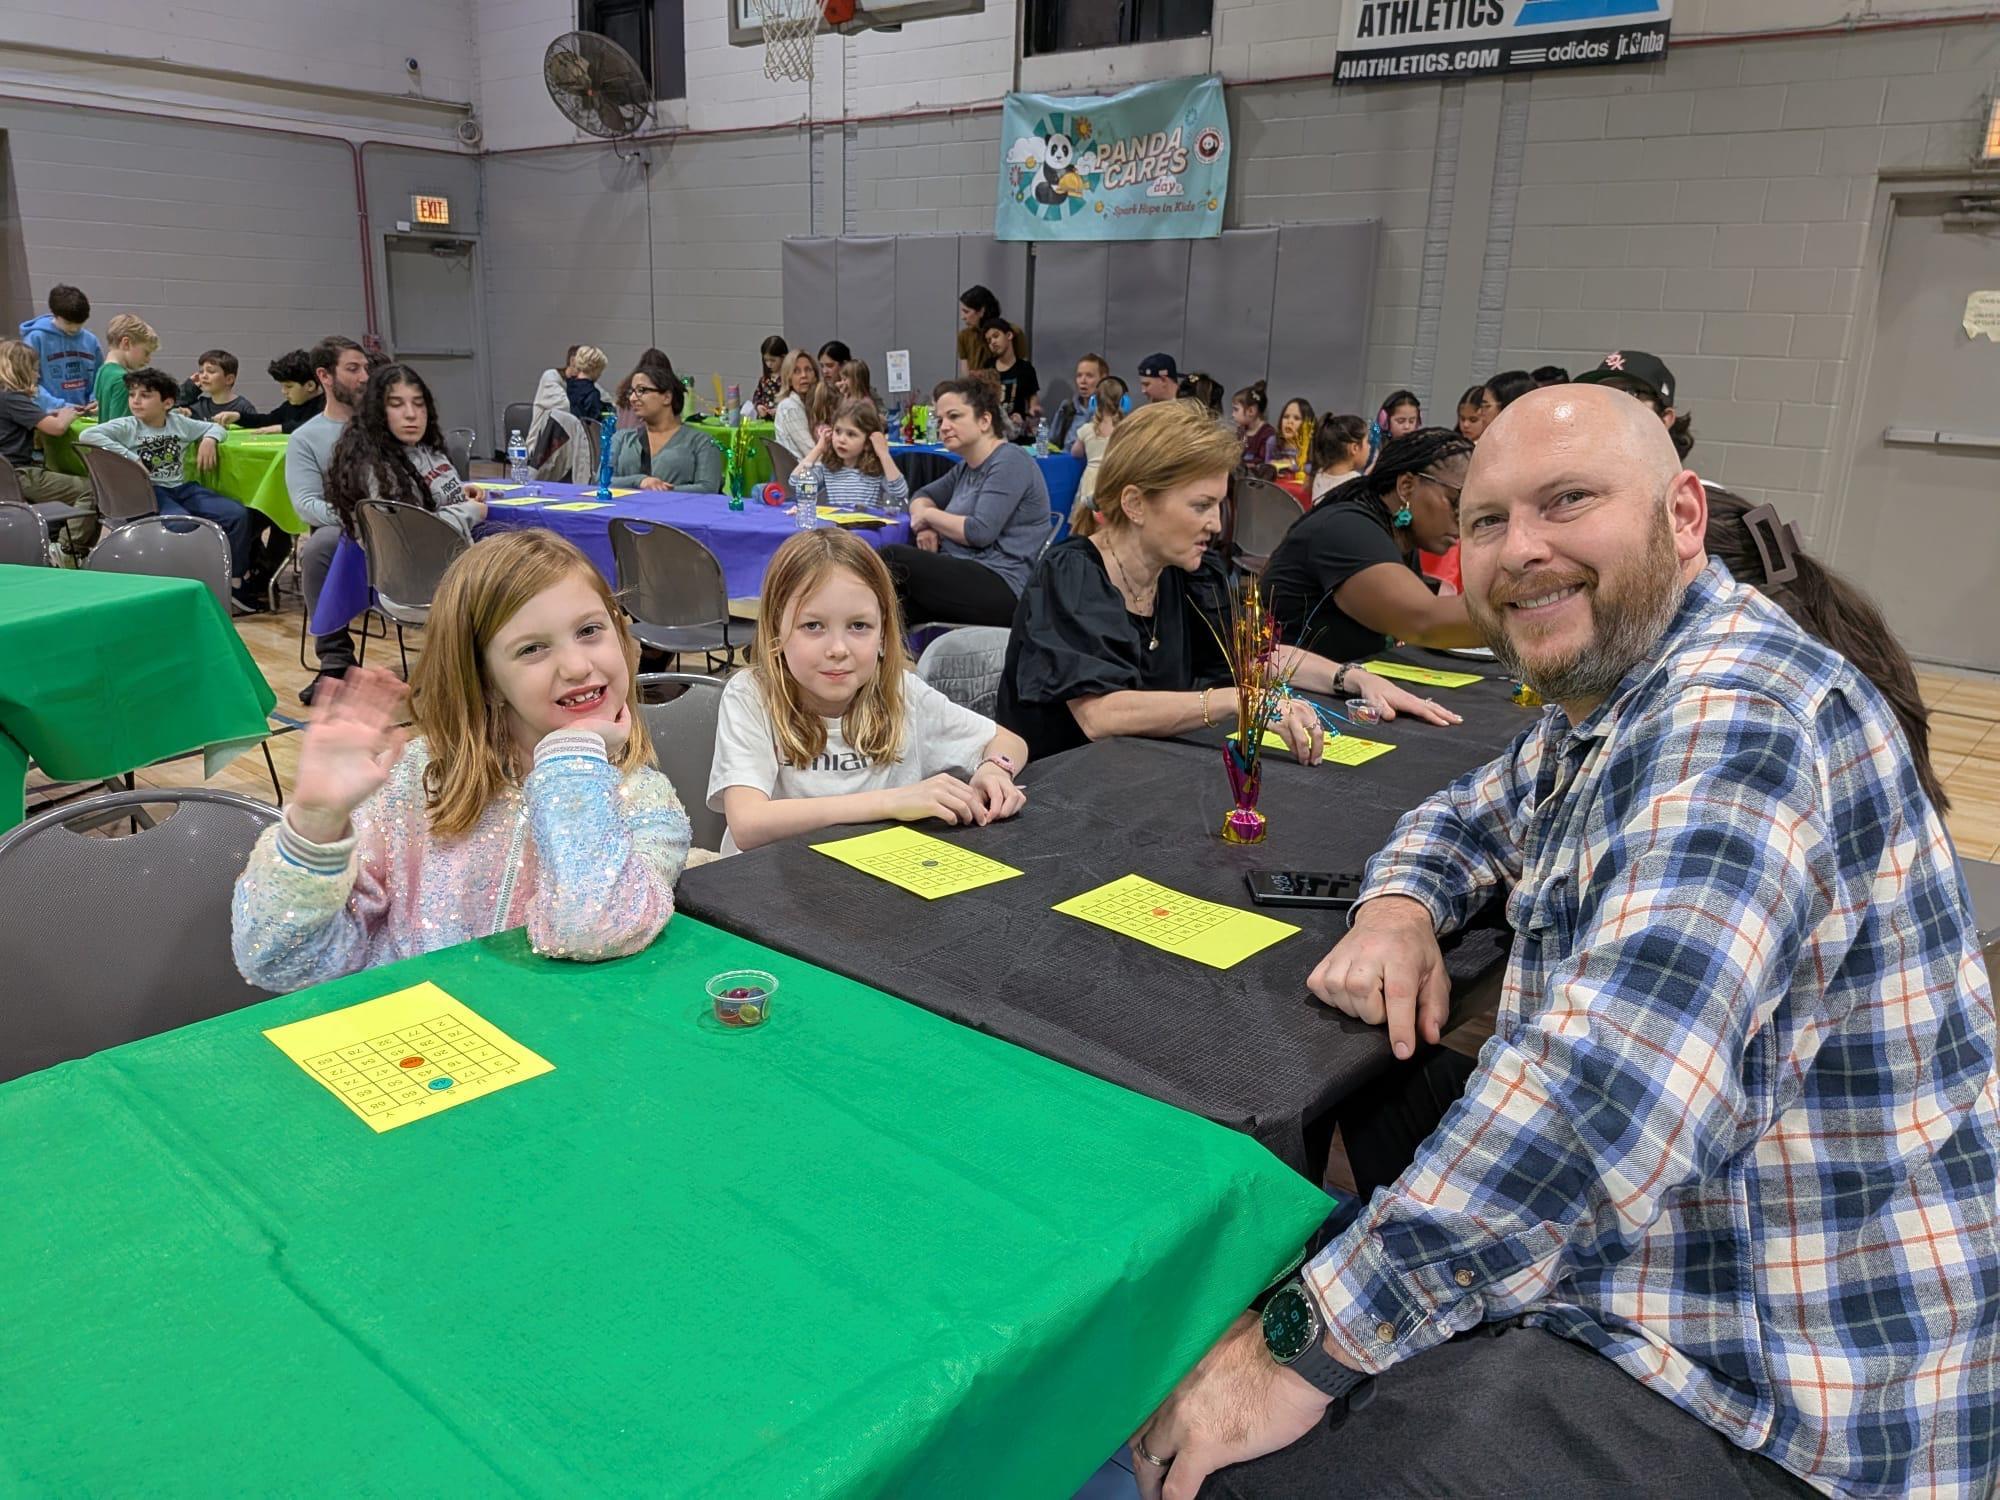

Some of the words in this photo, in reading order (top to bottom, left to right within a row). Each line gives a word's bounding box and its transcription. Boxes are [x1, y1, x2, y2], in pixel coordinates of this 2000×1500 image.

[1357, 0, 1505, 38] ATHLETICS
[1339, 48, 1500, 79] AIATHLETICS.COM
[1548, 40, 1609, 62] adidas
[1095, 126, 1183, 170] PANDA
[1104, 147, 1189, 190] CARES
[1153, 179, 1176, 195] day
[420, 199, 443, 219] EXIT
[1174, 200, 1196, 213] Kids
